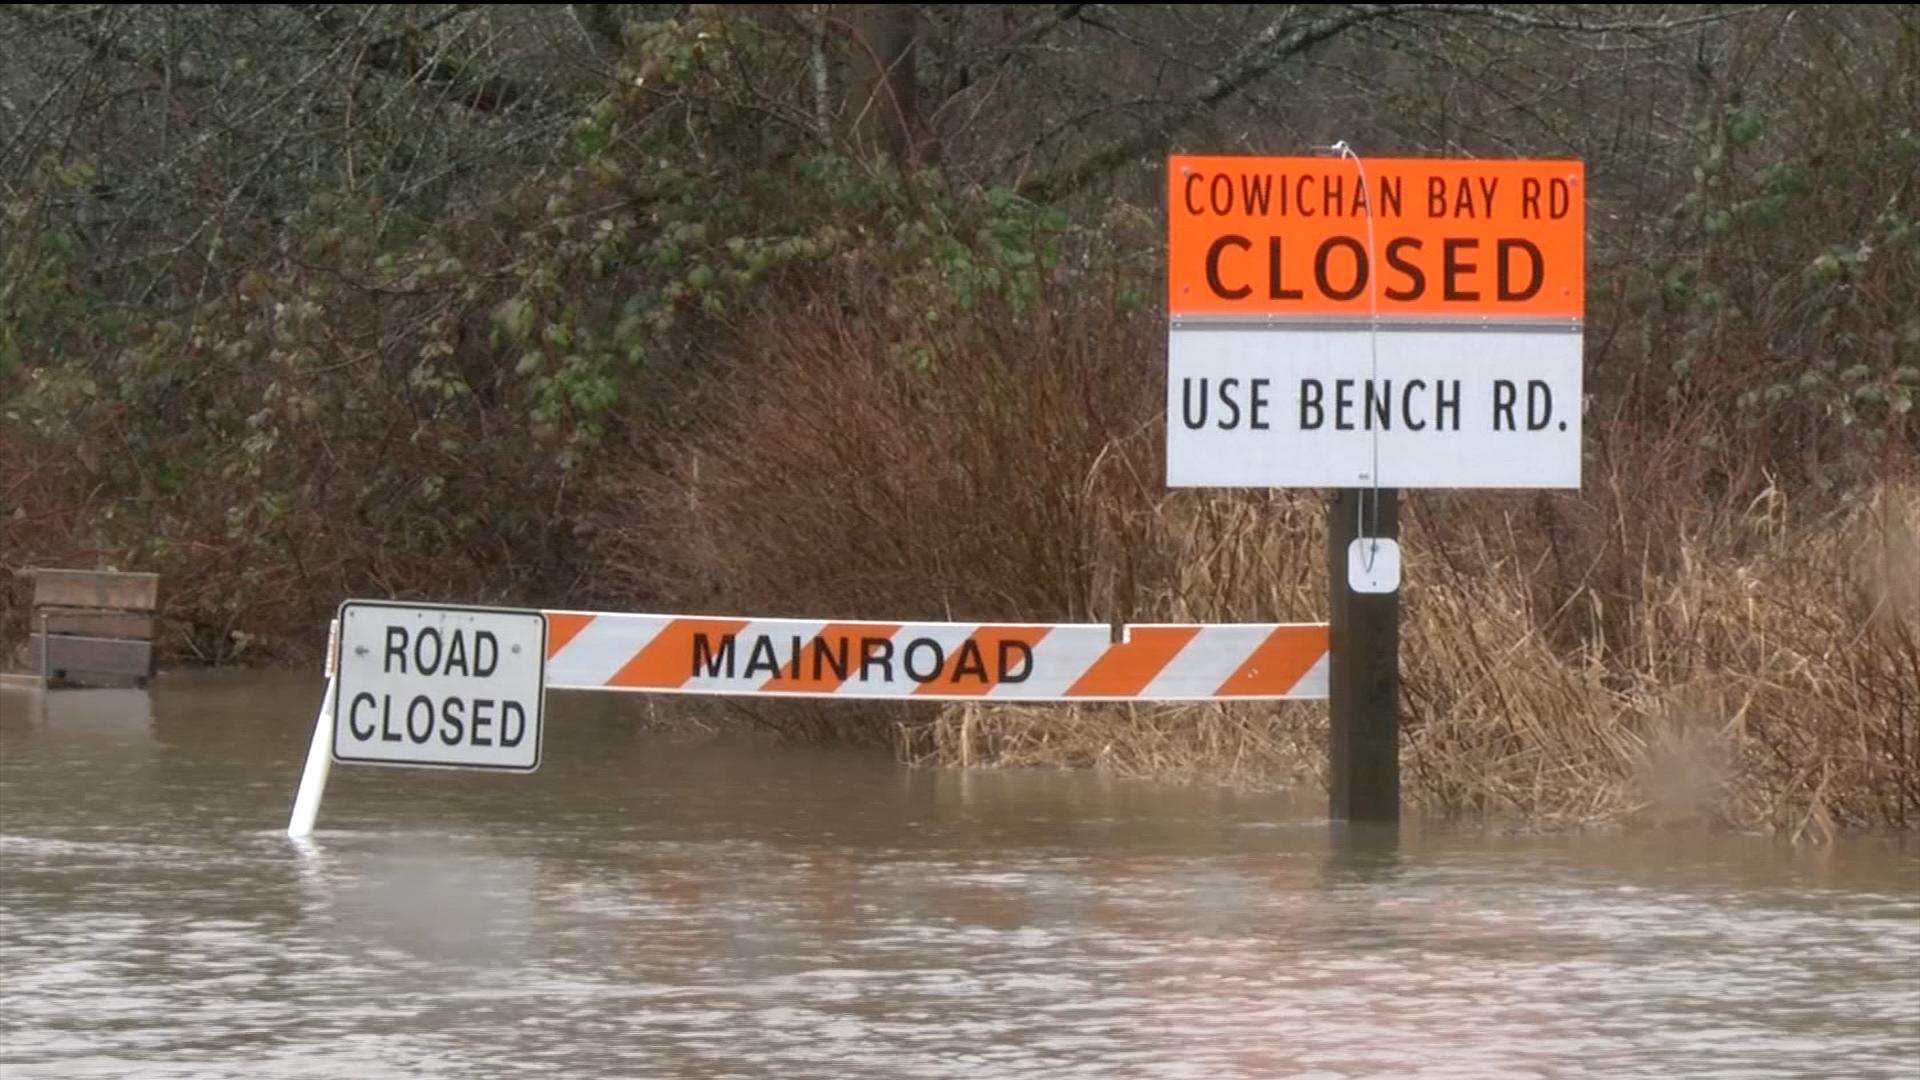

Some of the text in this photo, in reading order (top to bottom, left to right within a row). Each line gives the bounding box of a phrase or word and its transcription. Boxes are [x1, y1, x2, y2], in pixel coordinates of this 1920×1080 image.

[1184, 172, 1570, 220] COWICHAN BAY RD
[1205, 234, 1545, 302] CLOSED
[1182, 377, 1568, 432] USE BENCH RD.
[384, 625, 498, 678] ROAD
[691, 633, 1034, 685] MAINROAD
[349, 692, 526, 748] CLOSED
